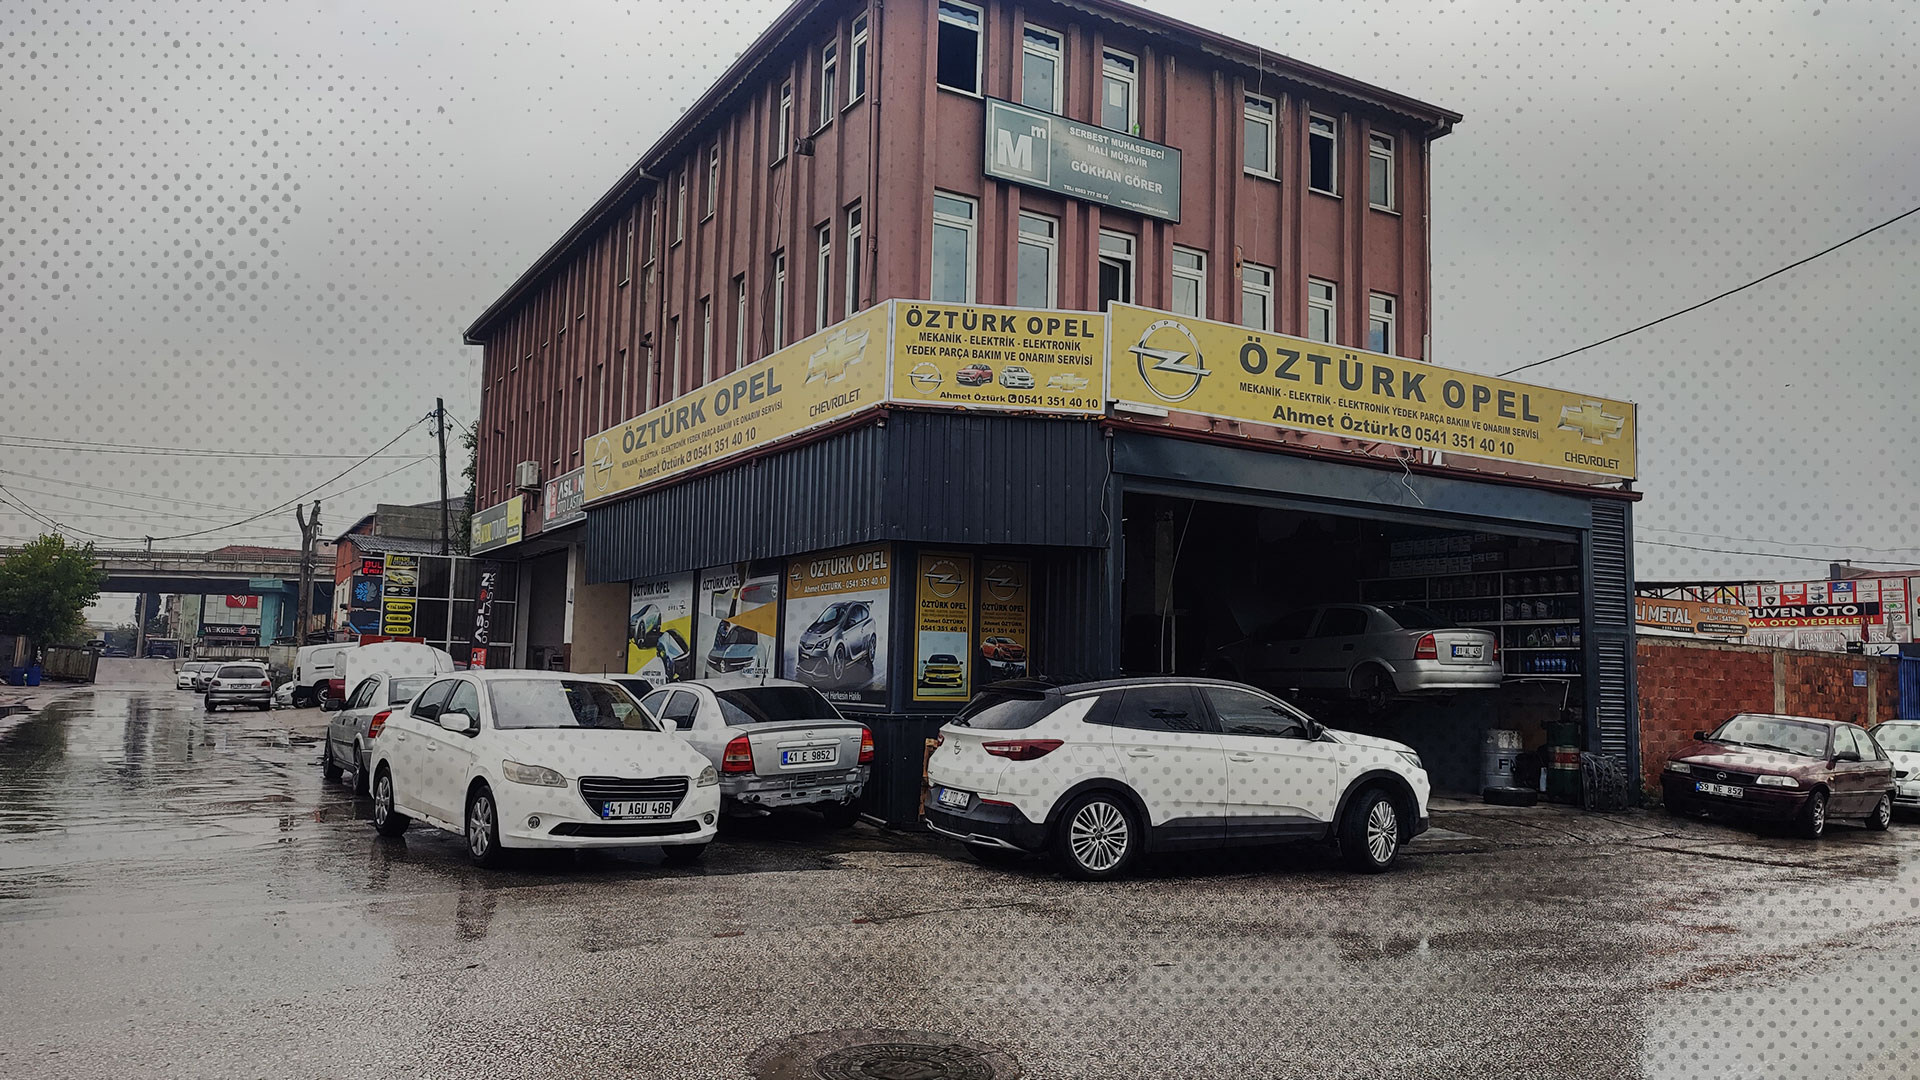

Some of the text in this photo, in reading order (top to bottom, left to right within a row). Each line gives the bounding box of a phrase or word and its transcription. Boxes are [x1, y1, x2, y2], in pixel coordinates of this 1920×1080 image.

[998, 128, 1033, 172] M
[1069, 126, 1165, 160] SERBEST MUHASEBECİ
[1087, 144, 1148, 168] MALİ MÜŞAVİR
[1071, 159, 1163, 194] GÖKHAN GÖRER
[906, 305, 1095, 338] ÖZTÜRK OPEL
[919, 331, 962, 344] MEKANİK
[970, 335, 1015, 348] ELEKTRİK
[1023, 338, 1081, 352] ELEKTRONİK
[906, 345, 1093, 366] YEDEK PARÇA BAKIM VE ONARIM SERVİSİ
[1239, 336, 1540, 423] ÖZTÜRK OPEL
[622, 367, 782, 454] ÖZTÜRK OPEL
[809, 388, 861, 418] CHEVROLET
[940, 391, 1098, 409] Ahmet Öztürk 0541 351 40 10
[1239, 382, 1281, 397] MEKANİK
[1289, 390, 1331, 405] ELEKTRİK
[1338, 398, 1390, 415] ELEKTRONİK
[1392, 407, 1418, 419] YEDEK
[1420, 411, 1444, 425] PARÇA
[1446, 417, 1470, 428] BAKIM
[1472, 420, 1481, 430] VE
[1483, 422, 1510, 435] ONARIM
[1512, 427, 1539, 440] SERVİSİ
[661, 440, 686, 455] ELEKTRONİK
[687, 432, 701, 445] YEDEK
[701, 428, 717, 441] PARÇA
[717, 421, 732, 433] BAKIM
[733, 417, 740, 427] VE
[740, 410, 761, 424] ONARIM
[761, 400, 783, 416] SERVİSİ
[1273, 405, 1514, 455] Ahmet Öztürk 0541 351 40 10
[638, 426, 756, 479] Ahmet Öztürk 0541 351 40 10
[1564, 452, 1620, 470] CHEVROLET
[810, 551, 887, 579] ÖZTÜRK OPEL
[634, 581, 670, 597] ÖZTÜRK OPEL
[703, 575, 739, 590] ÖZTÜRK OPEL
[804, 584, 820, 593] Ahmet
[845, 579, 858, 588] 0541
[860, 578, 870, 587] 351
[871, 576, 879, 585] 40
[880, 575, 887, 585] 10
[484, 572, 496, 616] LASTİK
[922, 600, 967, 610] ÖZTÜRK OPEL
[982, 602, 1024, 613] ÖZTÜRK OPEL
[1648, 605, 1692, 624] METAL
[1712, 606, 1729, 615] TÜRLÜ
[1749, 605, 1858, 618] GÜVEN OTO
[942, 617, 964, 625] ÖZTÜRK
[481, 620, 490, 644] OTO
[1800, 632, 1824, 643] KRANK
[789, 750, 831, 761] 41 E 9852
[610, 802, 671, 815] 41 AGU 486
